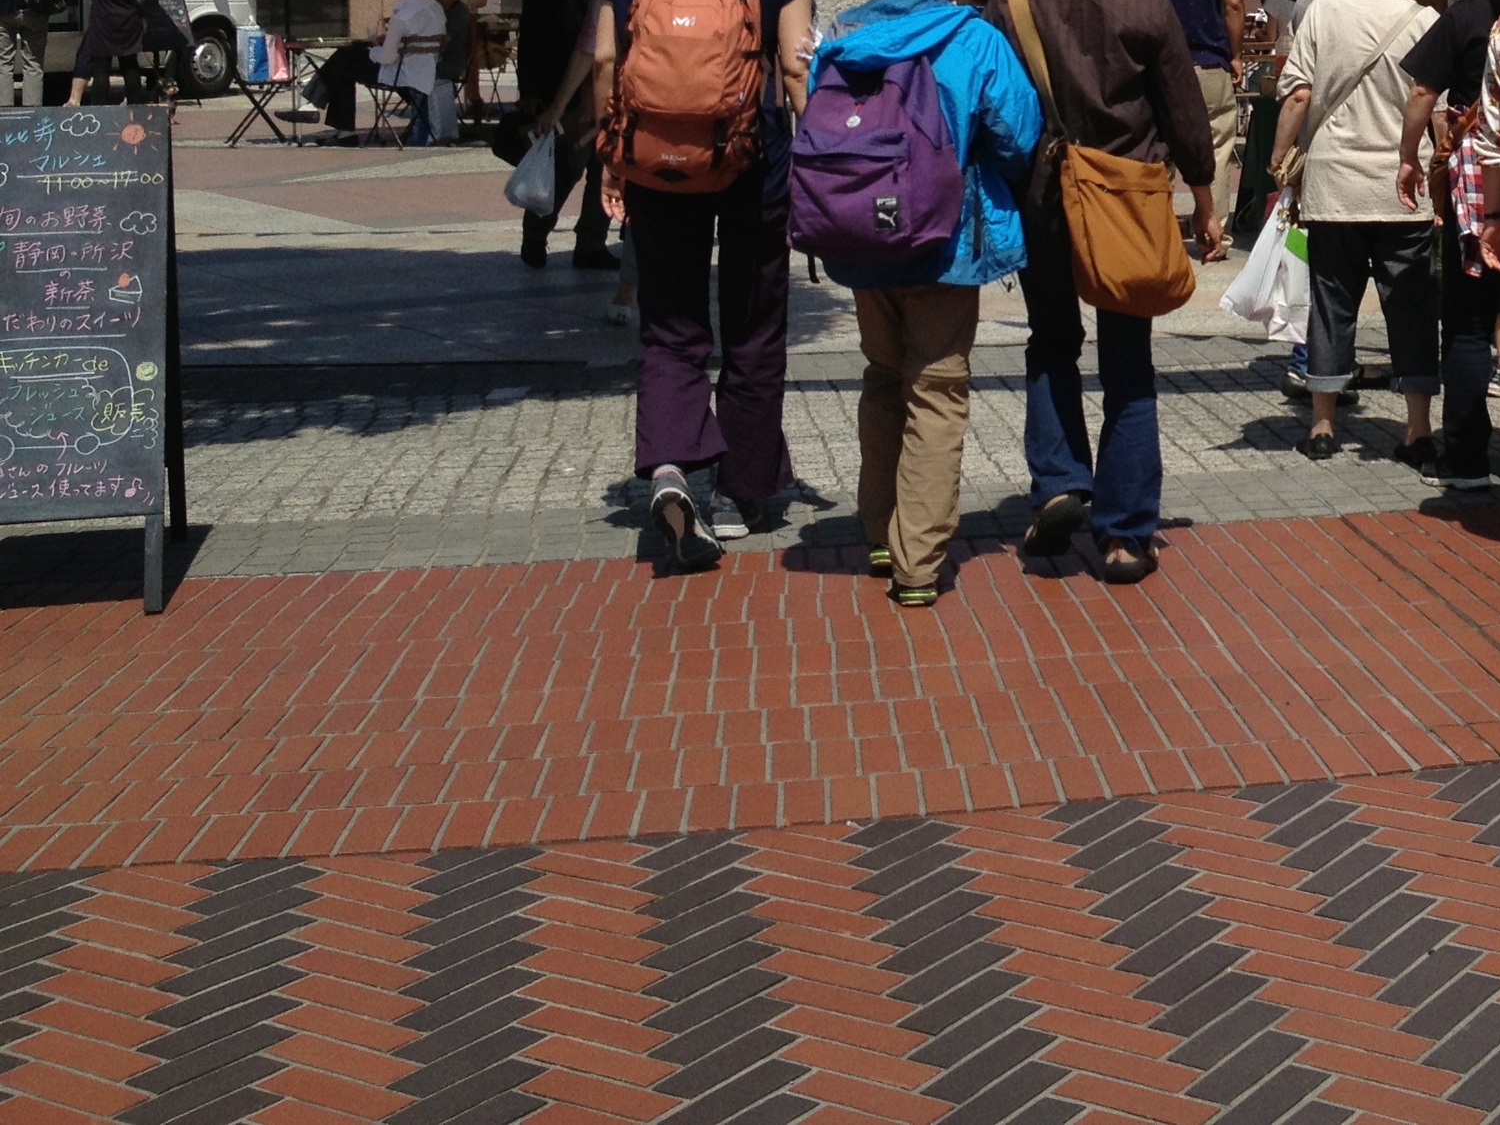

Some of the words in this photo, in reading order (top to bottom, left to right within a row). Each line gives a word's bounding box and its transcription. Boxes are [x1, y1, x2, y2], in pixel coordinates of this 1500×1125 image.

[29, 150, 107, 172] マルシェ
[30, 402, 85, 426] ジュース
[0, 460, 107, 480] さんのフルーツ
